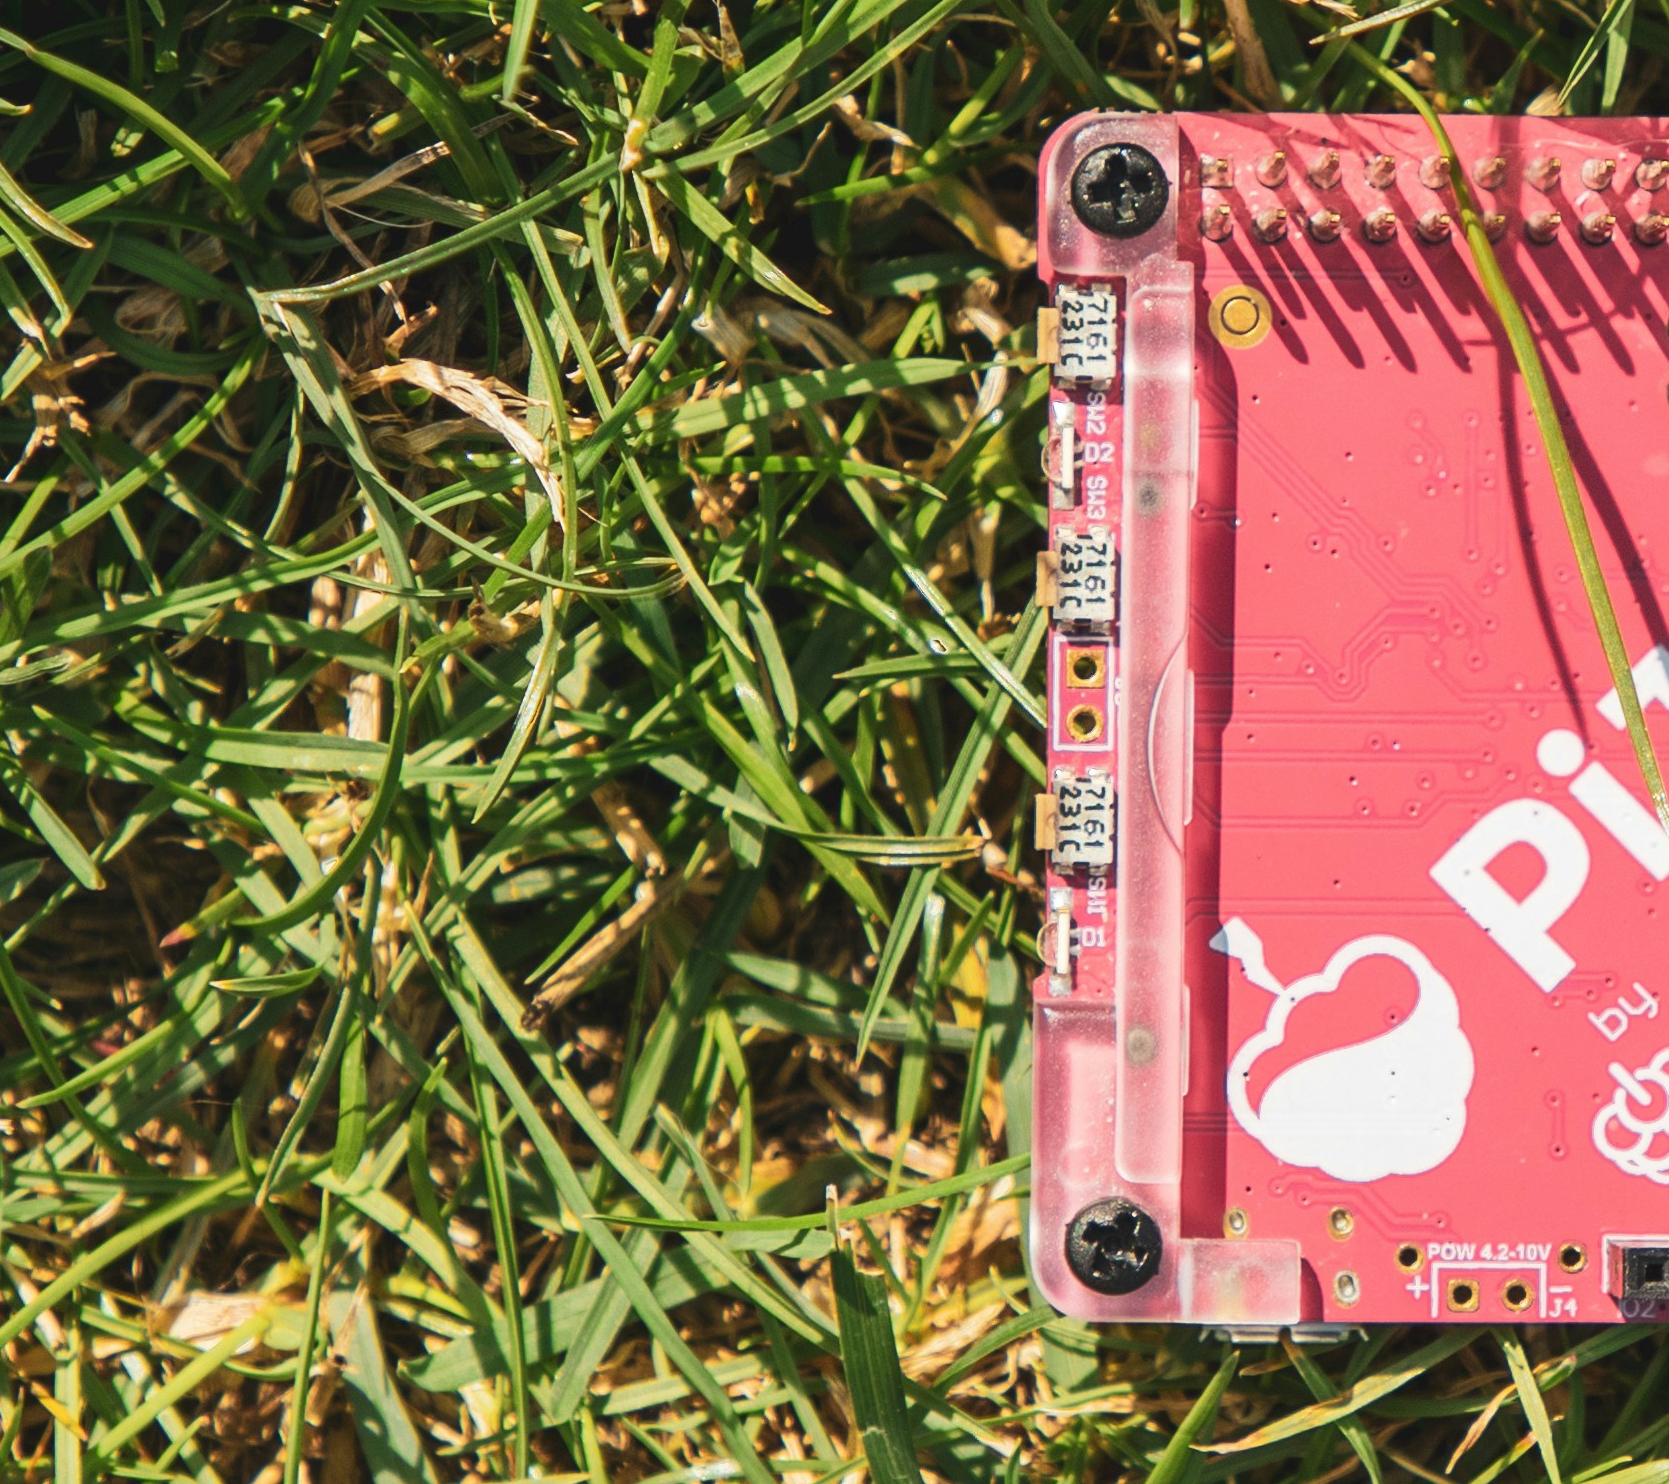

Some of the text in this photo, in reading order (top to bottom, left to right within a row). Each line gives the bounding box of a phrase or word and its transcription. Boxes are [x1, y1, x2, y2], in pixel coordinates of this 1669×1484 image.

[1086, 295, 1108, 362] 7161
[1087, 391, 1107, 435] SW2
[1084, 542, 1107, 604] 7161
[1082, 785, 1106, 849] 7161
[1587, 981, 1659, 1042] by
[1427, 1242, 1552, 1261] POW 4.2-10V
[1548, 1298, 1578, 1318] J4
